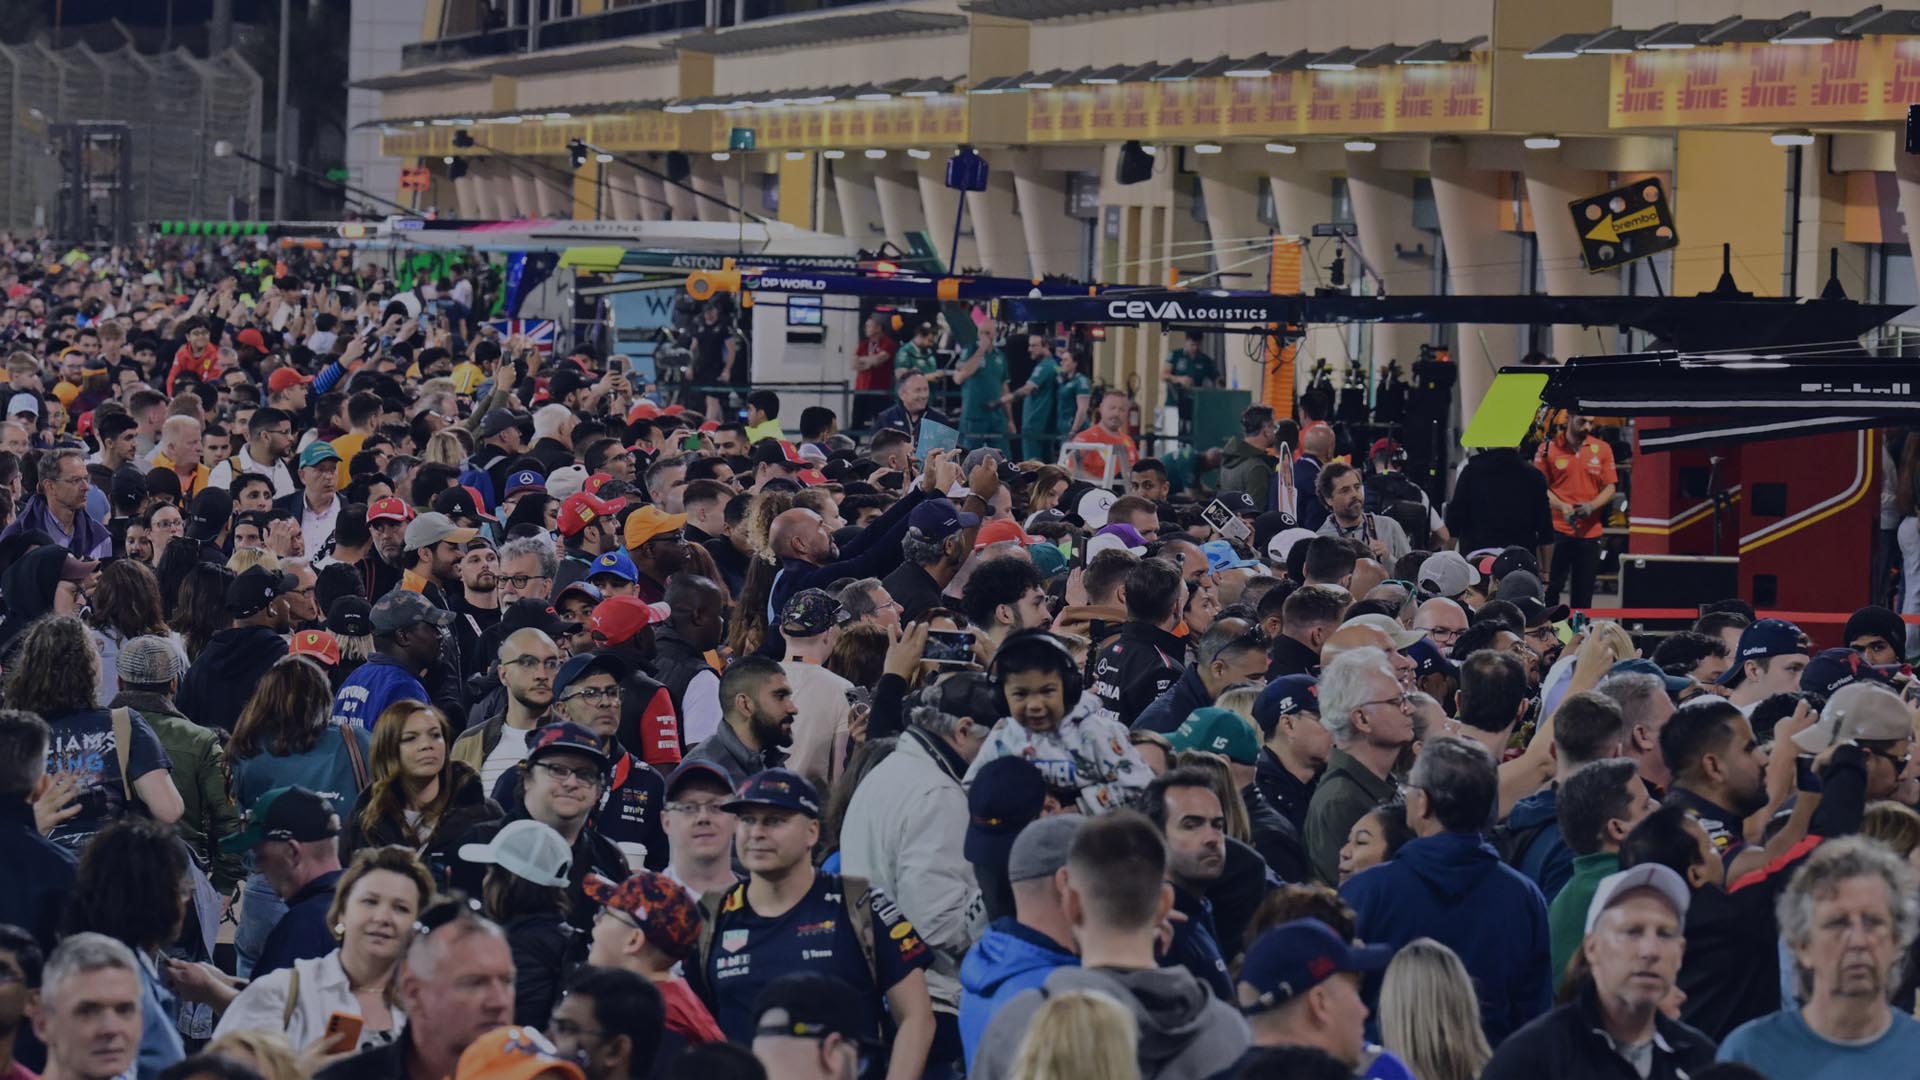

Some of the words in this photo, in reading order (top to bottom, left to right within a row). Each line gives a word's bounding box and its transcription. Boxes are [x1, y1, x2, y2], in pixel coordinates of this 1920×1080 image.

[568, 224, 641, 233] ALPINE
[1612, 212, 1657, 232] brembo
[672, 255, 721, 269] ASTON
[761, 277, 779, 288] DP
[780, 278, 826, 290] WORLD
[1187, 308, 1268, 320] LOGISTICS
